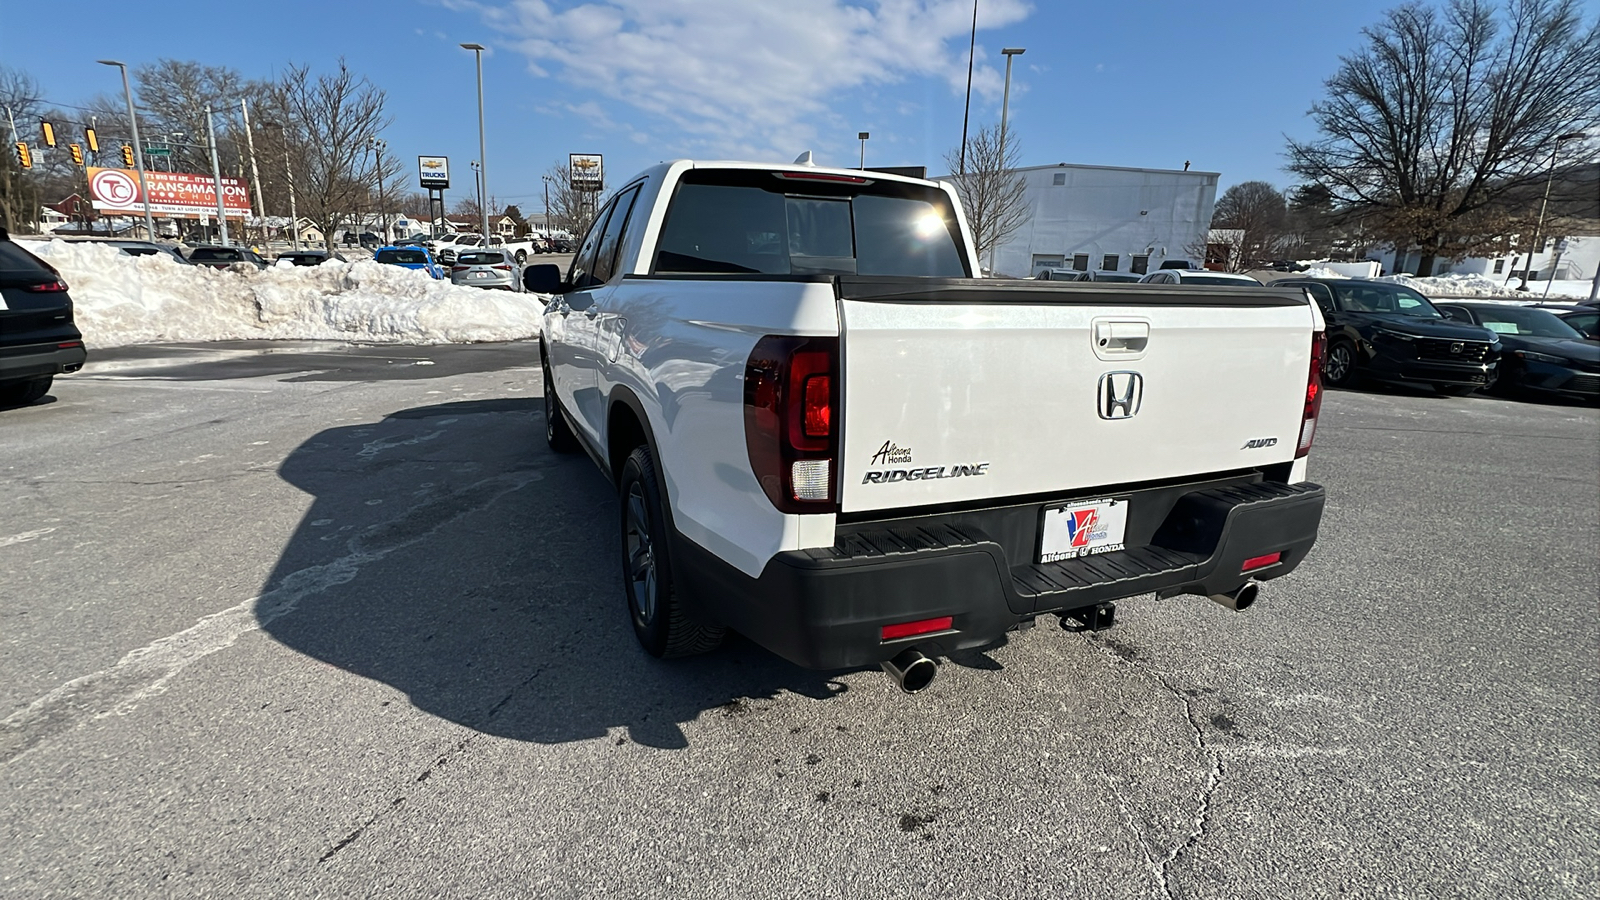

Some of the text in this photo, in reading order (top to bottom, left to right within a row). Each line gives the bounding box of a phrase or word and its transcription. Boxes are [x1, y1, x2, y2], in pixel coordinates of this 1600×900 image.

[138, 179, 246, 196] RANS4MAION
[179, 192, 247, 203] CHUCH
[1240, 437, 1278, 450] AWD
[888, 455, 912, 464] Honda
[861, 462, 990, 485] RIDGELINE
[1041, 551, 1077, 564] Altoona
[1091, 543, 1125, 555] HONDA
